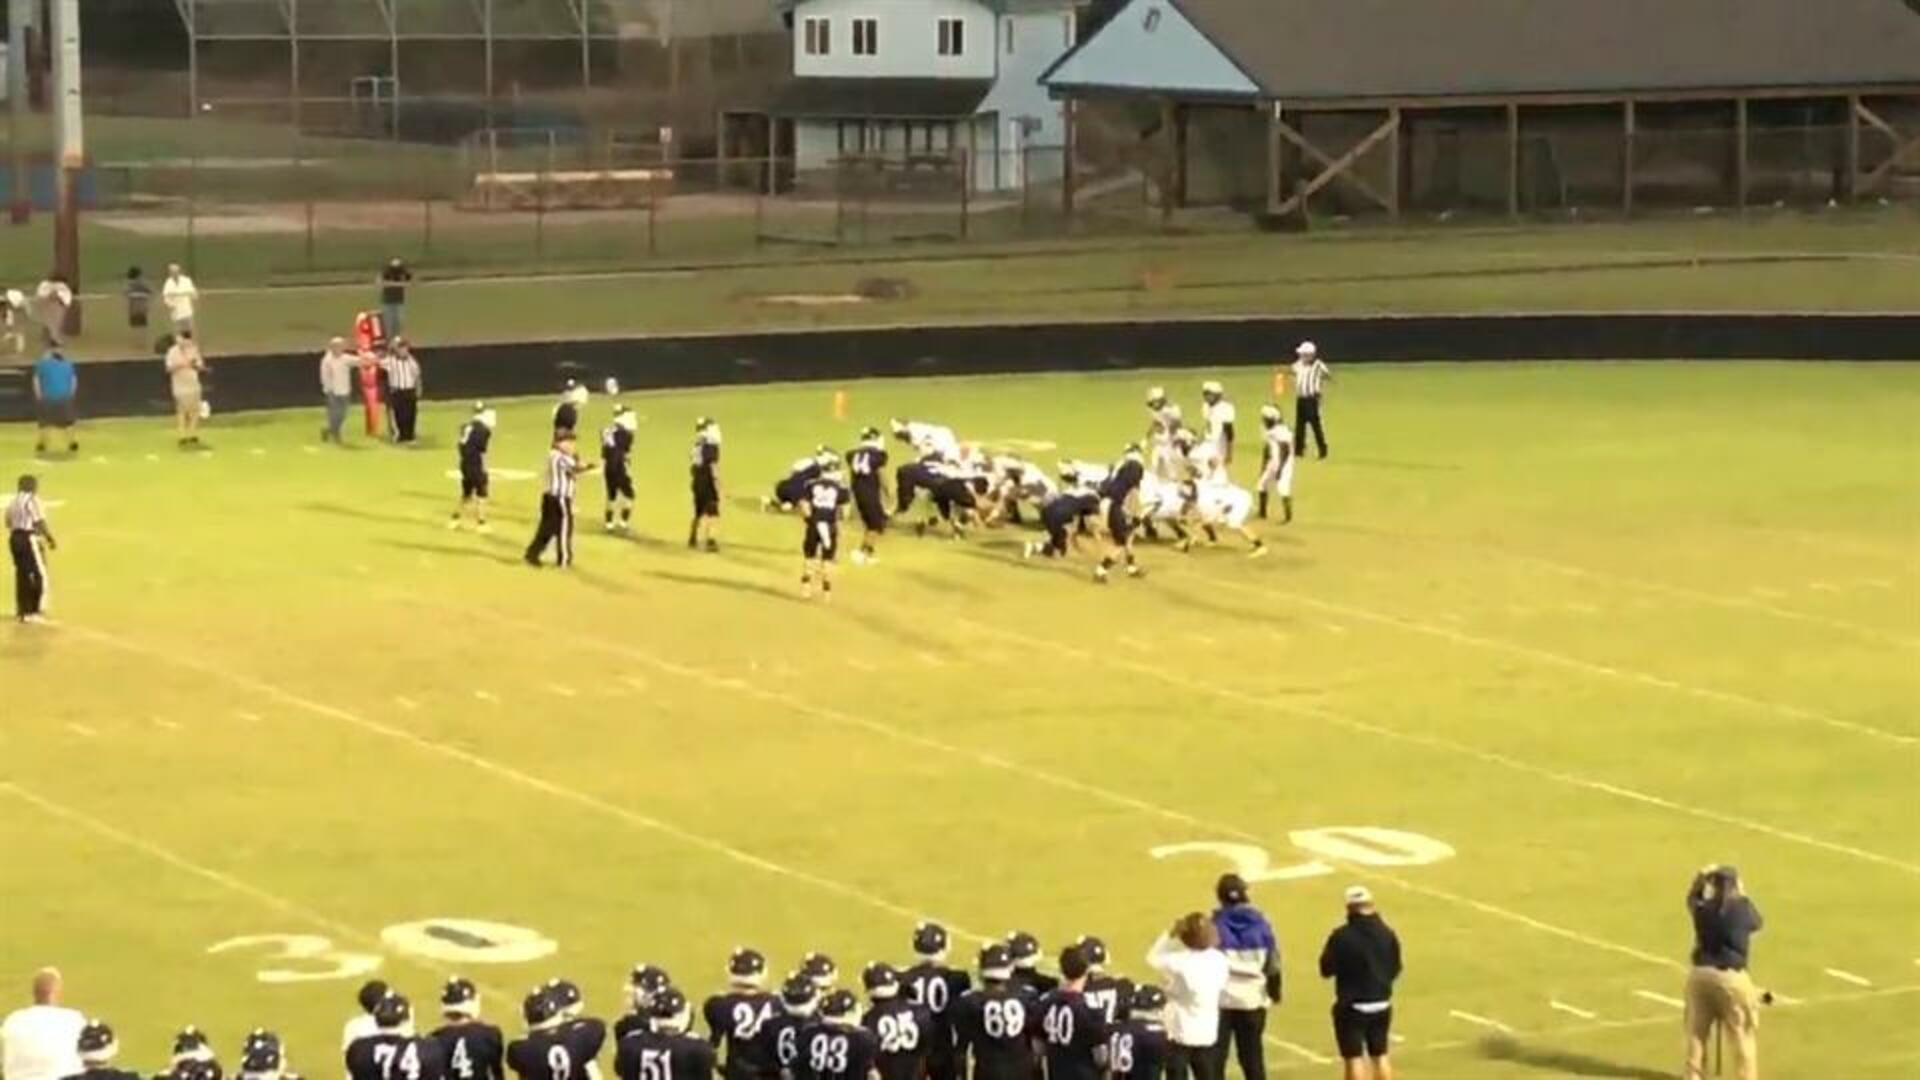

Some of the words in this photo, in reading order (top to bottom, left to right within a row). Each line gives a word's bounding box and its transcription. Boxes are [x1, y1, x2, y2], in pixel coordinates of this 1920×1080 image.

[1150, 826, 1456, 882] 20
[206, 918, 559, 983] 30
[909, 977, 948, 1012] 10
[878, 1010, 919, 1052] 25
[984, 999, 1025, 1038] 69
[1043, 1004, 1074, 1045] 40
[373, 1041, 421, 1080] 74
[451, 1036, 474, 1079] 4
[640, 1049, 672, 1080] 51
[809, 1033, 849, 1073] 93
